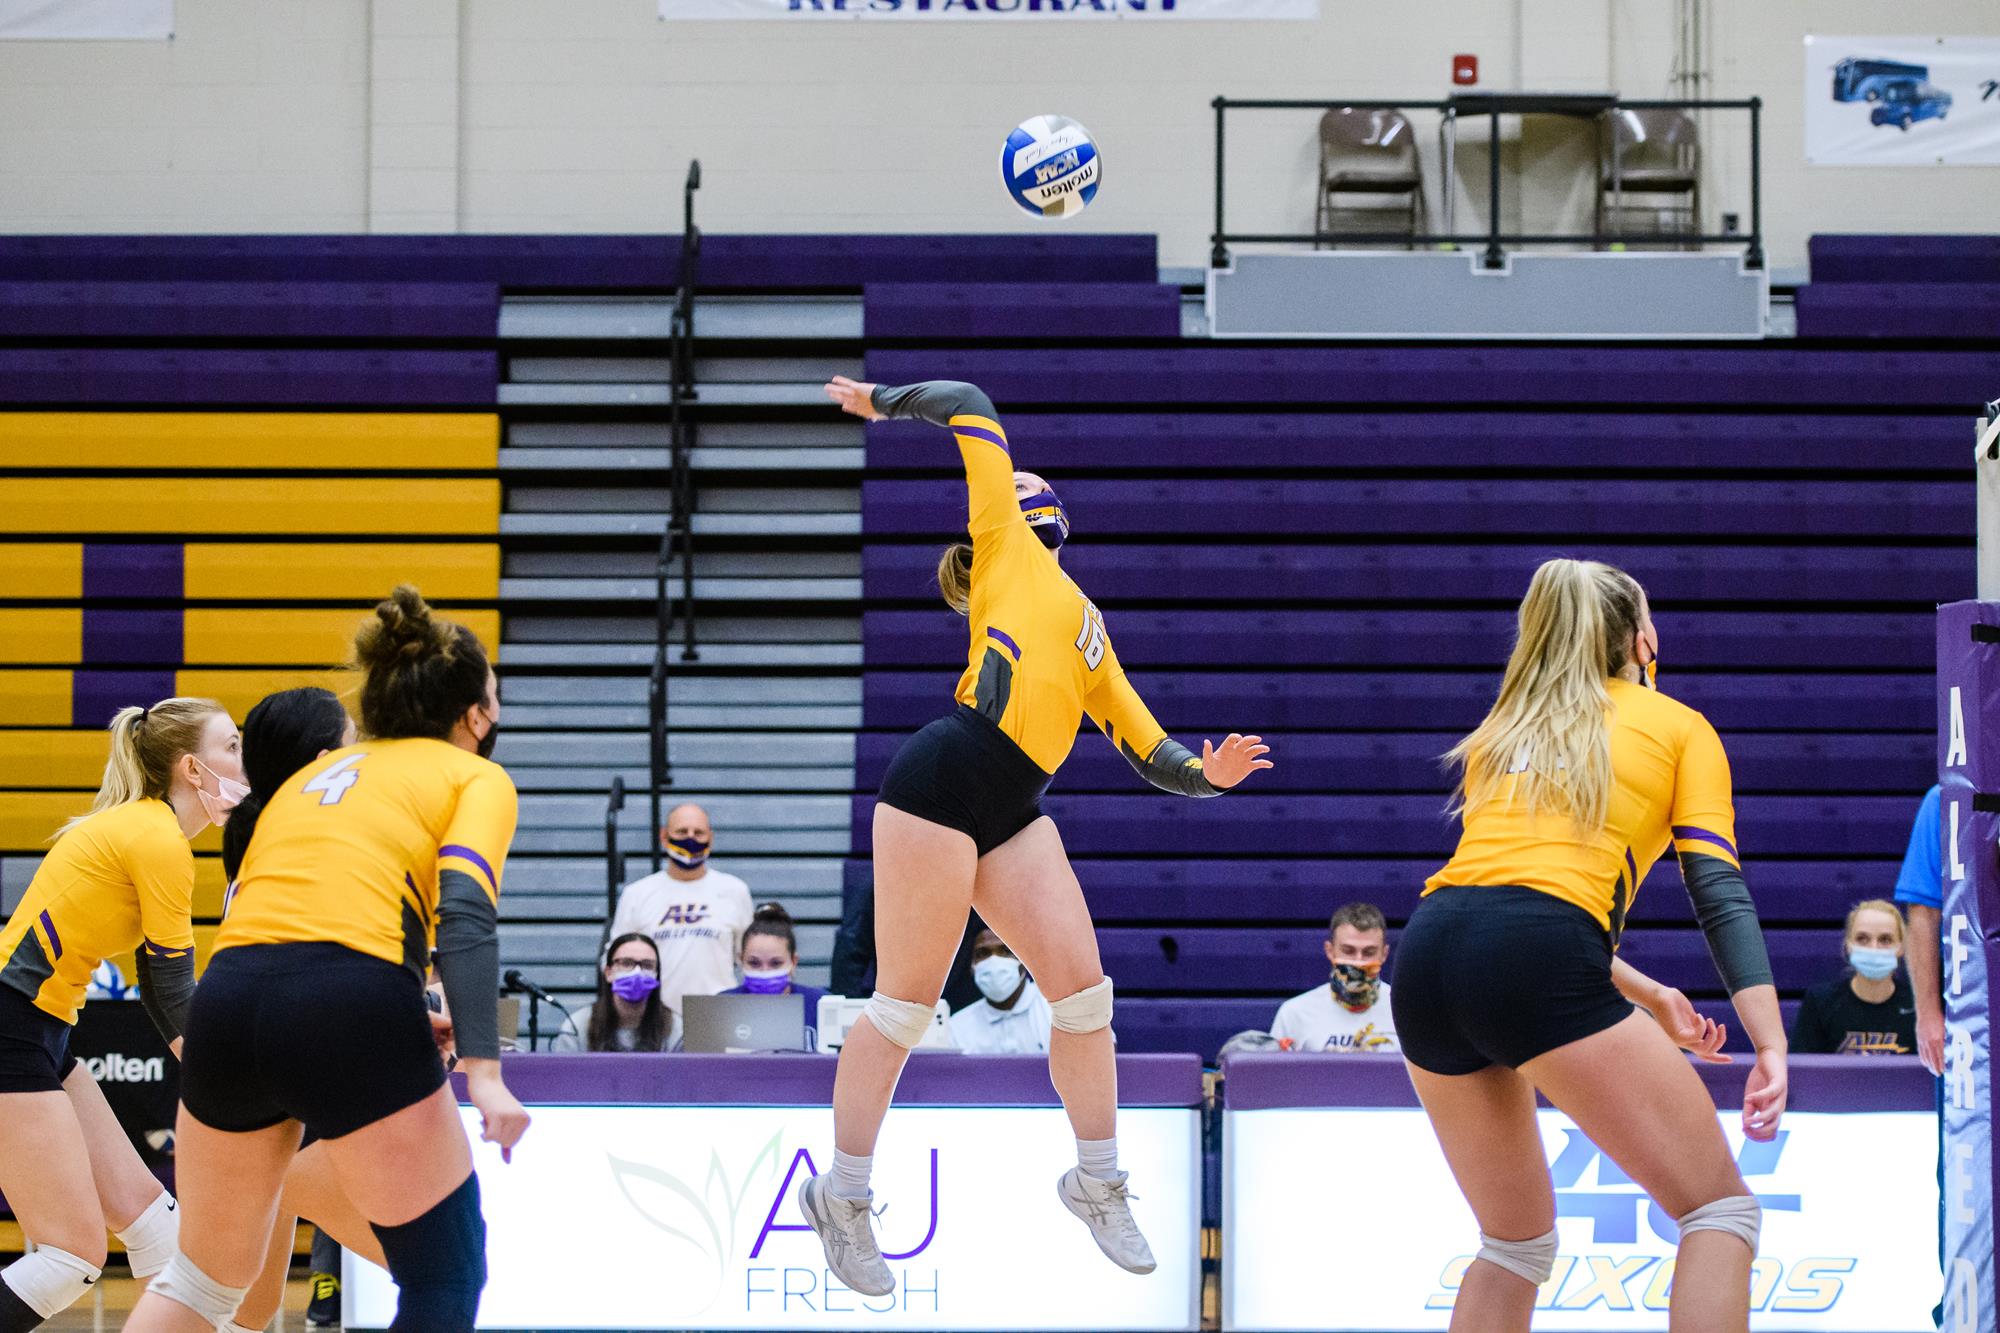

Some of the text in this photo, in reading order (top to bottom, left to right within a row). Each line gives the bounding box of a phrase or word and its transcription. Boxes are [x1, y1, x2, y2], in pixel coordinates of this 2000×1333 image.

[1034, 148, 1080, 185] NCAA
[1041, 165, 1093, 198] molten
[1074, 604, 1105, 672] 16
[301, 752, 369, 806] 4
[659, 904, 708, 926] AU
[1946, 686, 1978, 1333] ALFRED
[75, 1053, 163, 1083] olten
